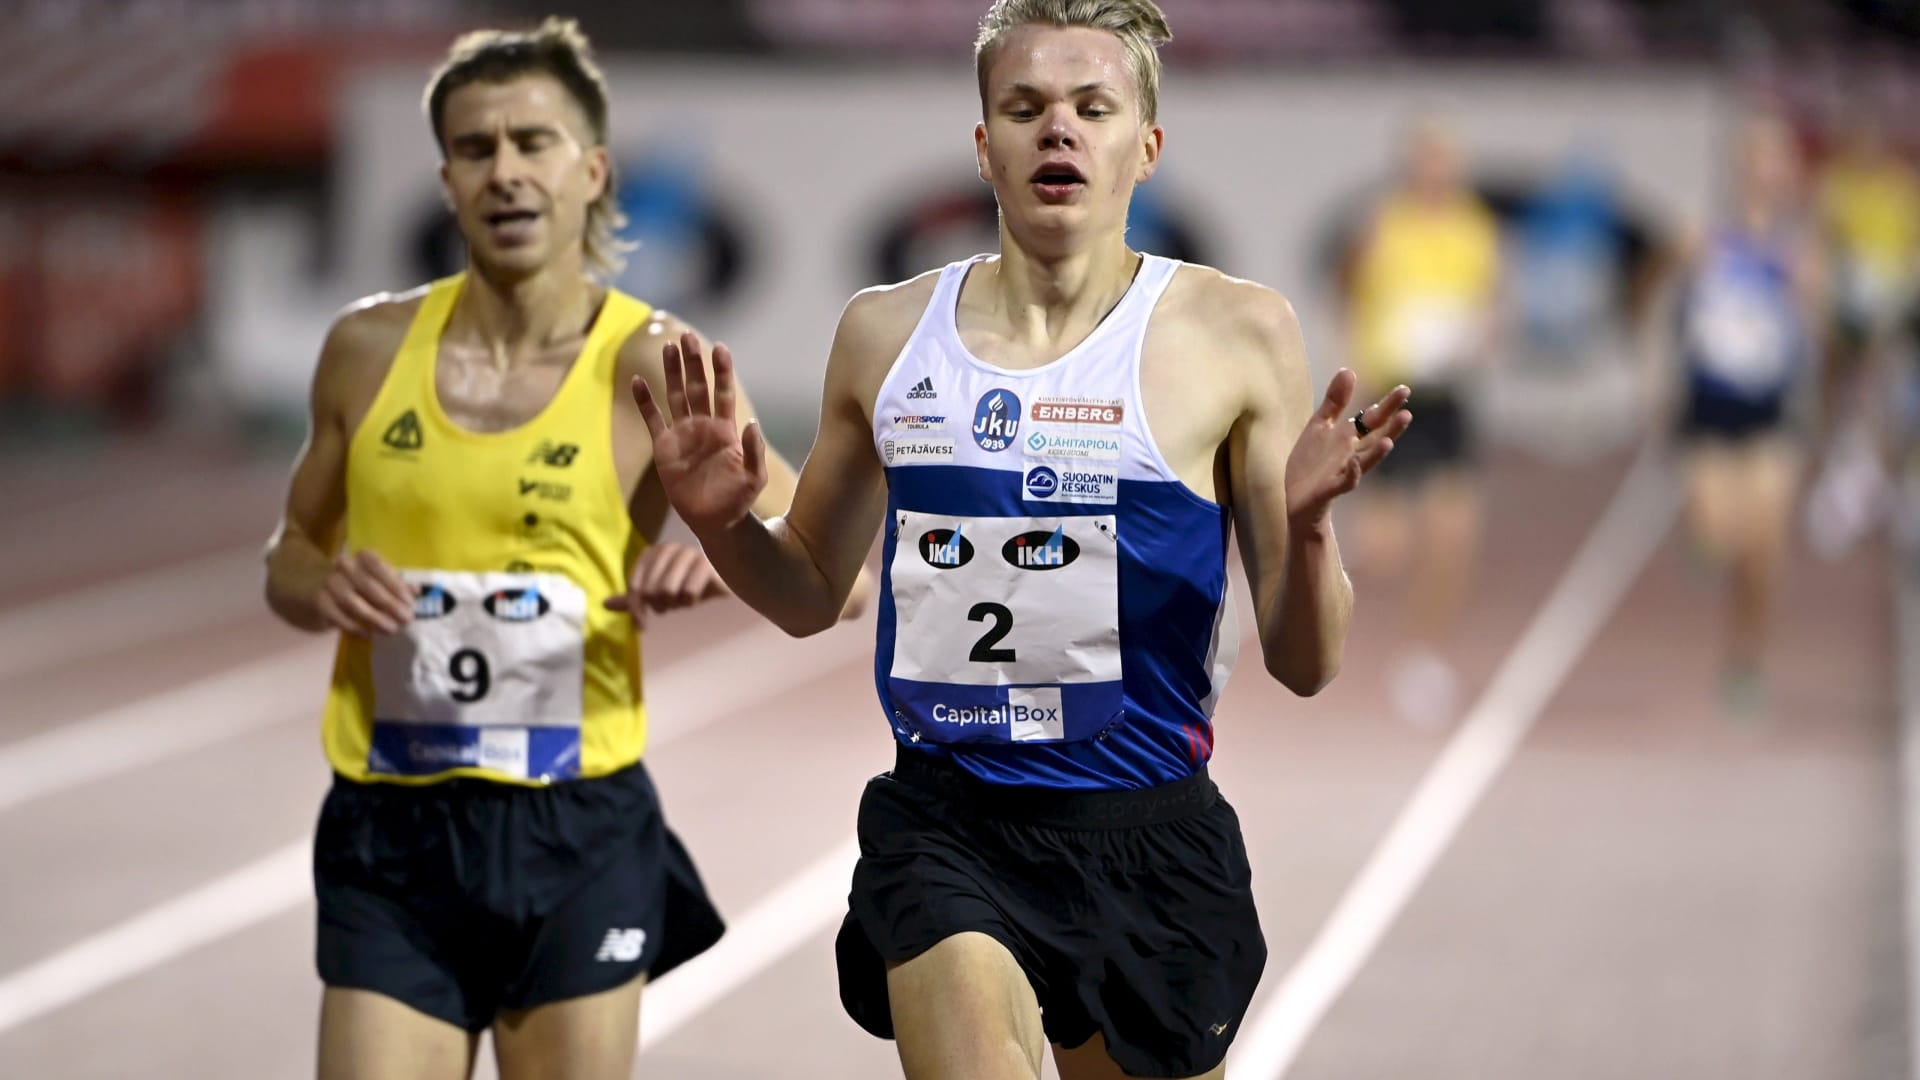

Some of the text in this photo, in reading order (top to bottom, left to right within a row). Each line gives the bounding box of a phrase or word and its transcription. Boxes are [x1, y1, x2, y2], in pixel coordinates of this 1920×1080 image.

[906, 390, 937, 399] adidas
[900, 415, 946, 424] INTERSPORT
[1038, 405, 1115, 422] ENBERG
[896, 443, 953, 455] PETÄJÄVESI
[1048, 435, 1118, 450] LÄHITAPIOLA
[1061, 482, 1101, 494] KESKUS
[967, 601, 1017, 663] 2
[449, 647, 490, 703] 9
[932, 703, 1058, 727] Capital Box
